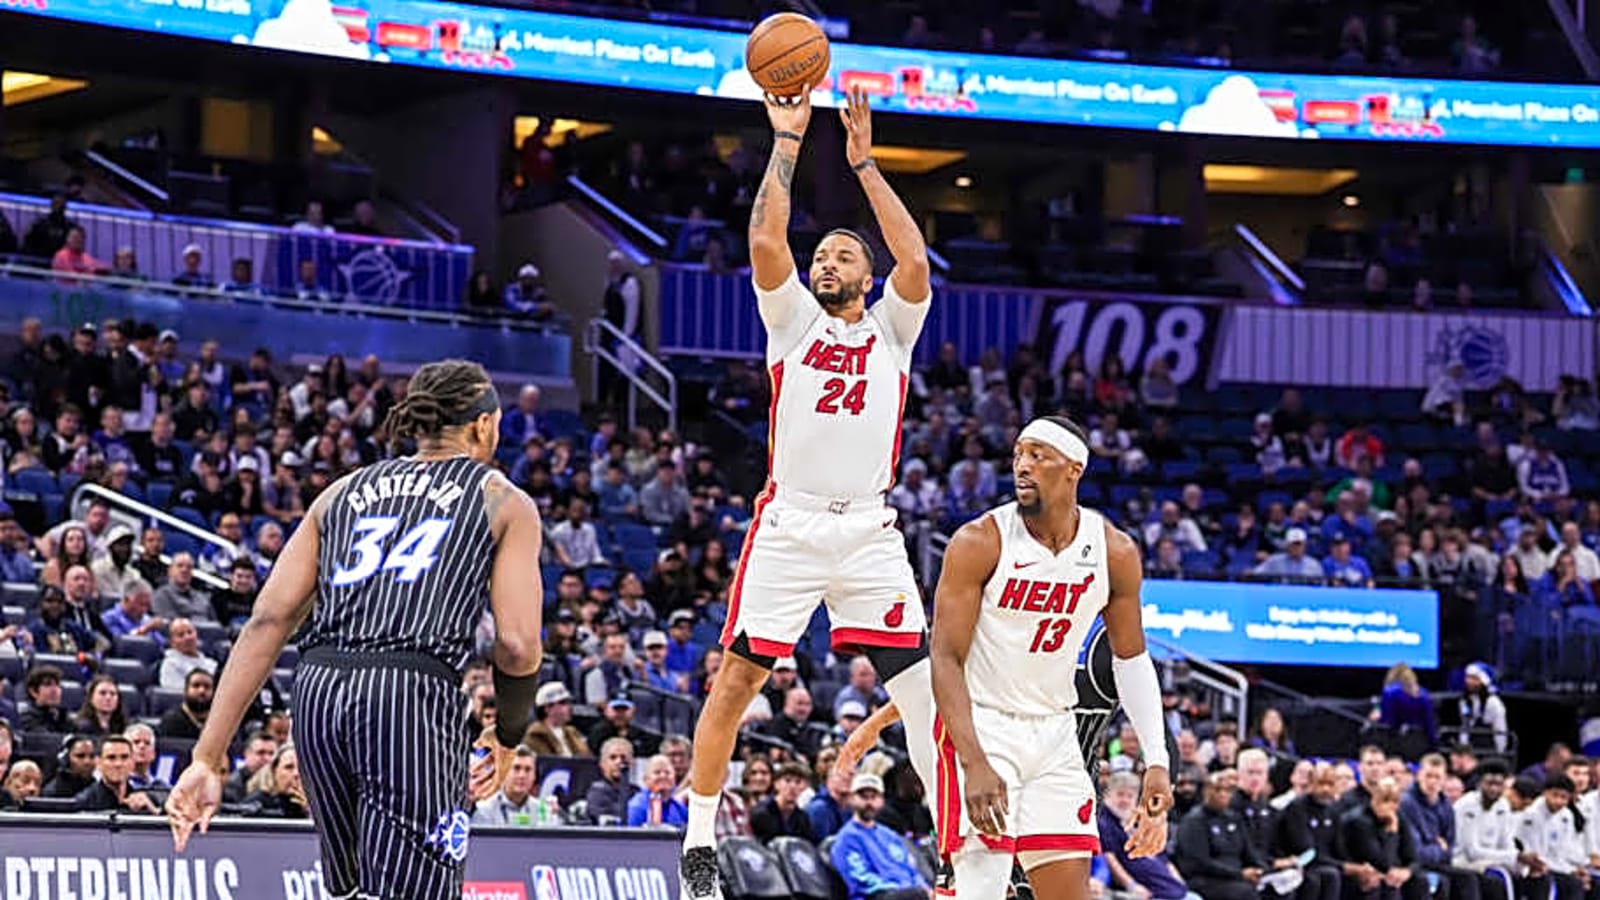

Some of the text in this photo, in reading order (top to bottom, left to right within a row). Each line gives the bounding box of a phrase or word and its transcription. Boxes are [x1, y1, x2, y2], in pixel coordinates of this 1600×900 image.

[801, 333, 876, 376] HEAT
[1049, 300, 1205, 387] 108
[815, 377, 868, 416] 24
[347, 473, 432, 514] CARTER
[331, 513, 453, 588] 34
[998, 572, 1095, 615] HEAT
[1029, 617, 1072, 654] 13
[1, 856, 238, 900] RTERFINALS
